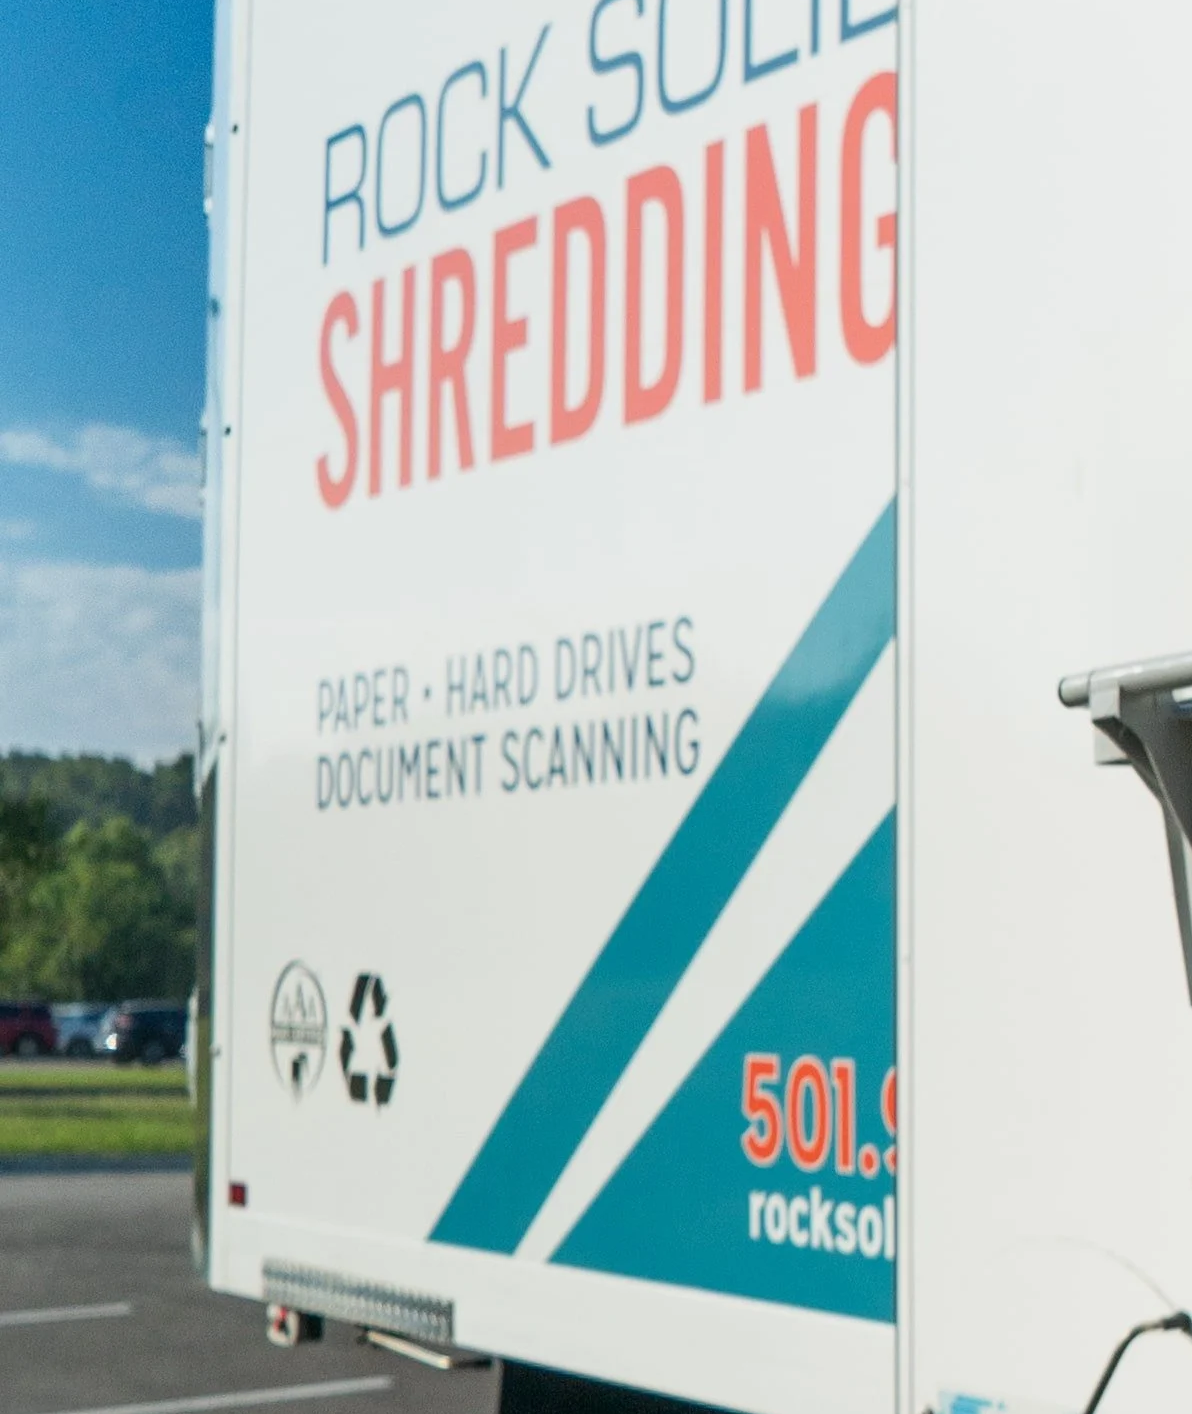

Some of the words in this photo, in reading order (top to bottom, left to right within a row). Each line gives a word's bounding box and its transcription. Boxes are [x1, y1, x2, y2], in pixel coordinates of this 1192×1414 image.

[324, 22, 551, 266] ROCK
[316, 70, 897, 510] SHREDDING
[317, 665, 409, 733] PAPER
[446, 644, 539, 716] HARD
[554, 616, 695, 701] DRIVES
[317, 734, 487, 810] DOCUMENT
[502, 706, 700, 793] SCANNING
[749, 1185, 895, 1261] rocksol
